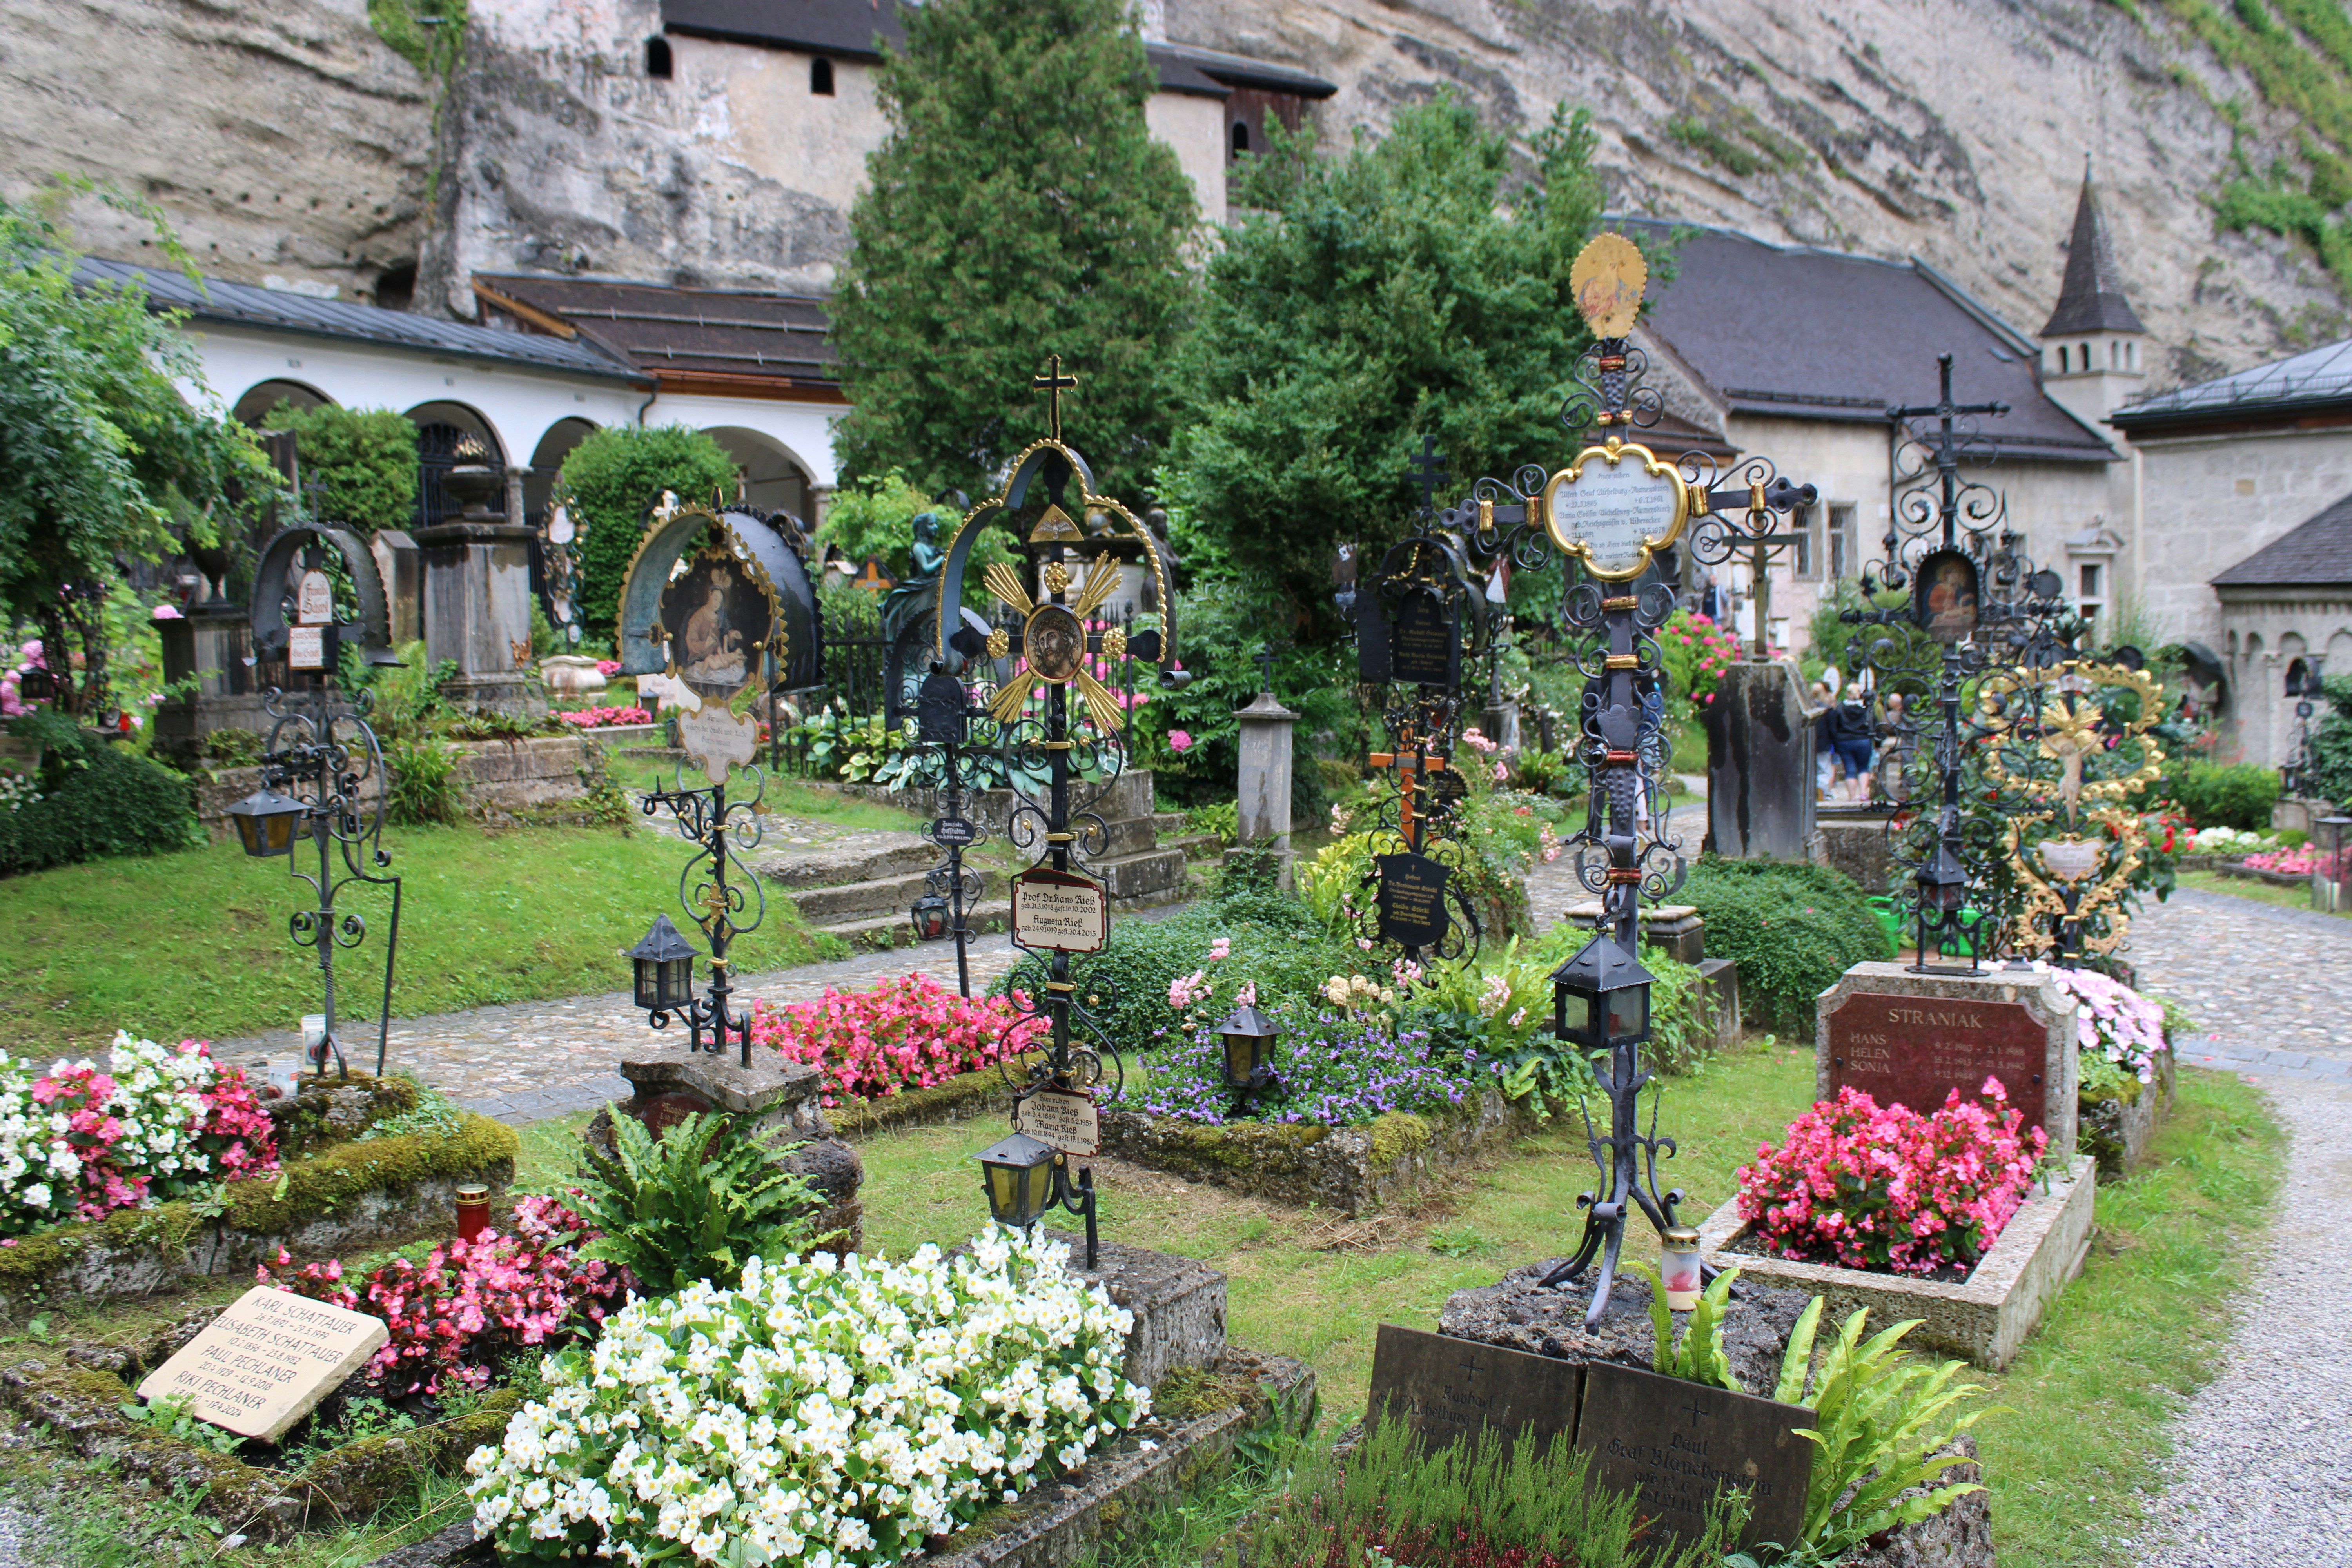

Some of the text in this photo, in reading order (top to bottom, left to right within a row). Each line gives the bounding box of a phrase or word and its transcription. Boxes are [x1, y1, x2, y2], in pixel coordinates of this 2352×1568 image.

[1022, 892, 1040, 902] Prof.
[1075, 895, 1095, 906] Rieß
[1033, 915, 1083, 929] Augusta Rieß
[1889, 1009, 1982, 1029] STRANIAK
[1850, 1031, 1887, 1045] HANS
[1851, 1047, 1891, 1059] HELEN
[1039, 1094, 1070, 1105] Hier ruhen
[1031, 1101, 1078, 1117] Johann Rieß
[1035, 1119, 1077, 1135] Maria Rieß
[251, 1296, 358, 1335] KARL SCHATTAUER
[254, 1312, 289, 1328] 26.7.1892
[293, 1324, 330, 1340] 29.5.1979
[211, 1316, 343, 1364] ELISABETH SCHATTAUER
[227, 1337, 259, 1352] 10.2.1896
[201, 1345, 298, 1383] PAUL PECHLANER
[198, 1361, 234, 1377] 20.4.1929
[238, 1375, 274, 1391] 12.9.2018
[174, 1371, 267, 1410] RIKI PECHLANER
[206, 1400, 243, 1417] 19.4.2024
[1608, 1438, 1646, 1464] Graf
[1670, 1432, 1708, 1455] Paul
